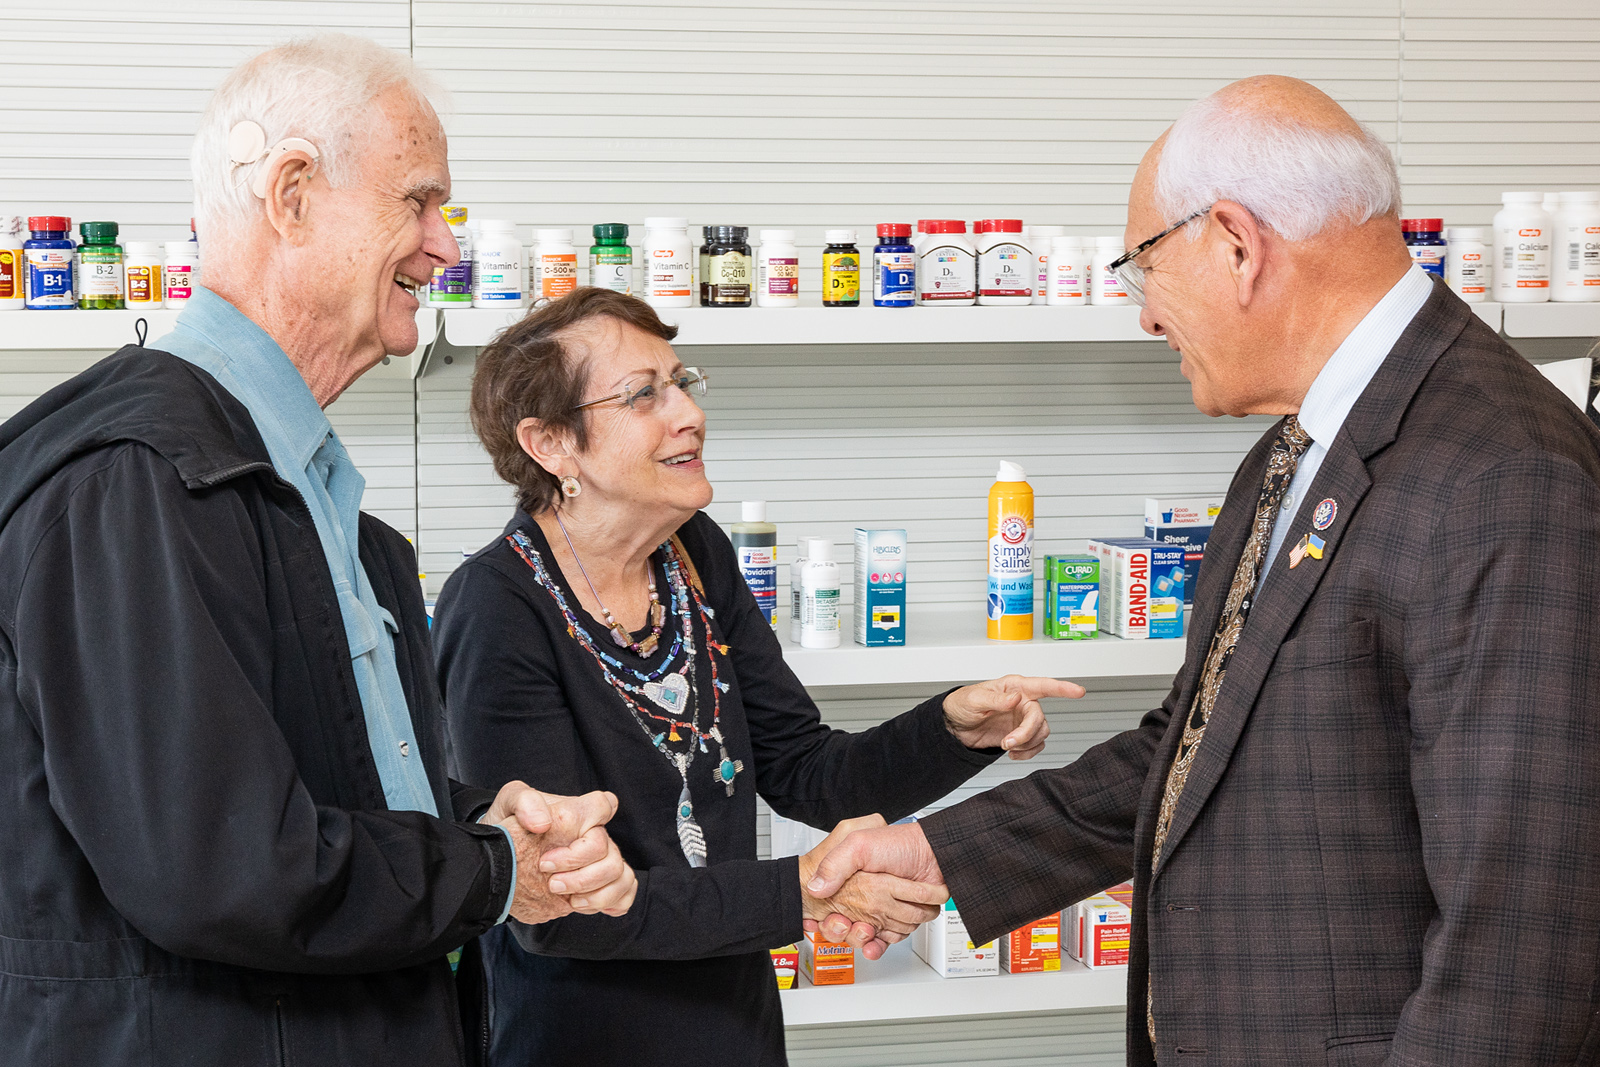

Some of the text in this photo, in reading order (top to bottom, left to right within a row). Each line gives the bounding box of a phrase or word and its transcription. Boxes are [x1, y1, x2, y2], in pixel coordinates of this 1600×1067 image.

[96, 266, 113, 274] B-2
[616, 266, 623, 276] C
[44, 274, 62, 286] B-1
[131, 280, 147, 288] B-6
[171, 278, 188, 286] B-6
[1164, 535, 1189, 543] Sheer
[993, 544, 1032, 558] Simply
[994, 556, 1030, 568] Saline
[1065, 566, 1092, 574] CURAD
[990, 582, 1016, 590] Wound
[1129, 553, 1148, 627] BAND-AID
[817, 946, 845, 955] Motrin
[1012, 931, 1020, 964] Infants
